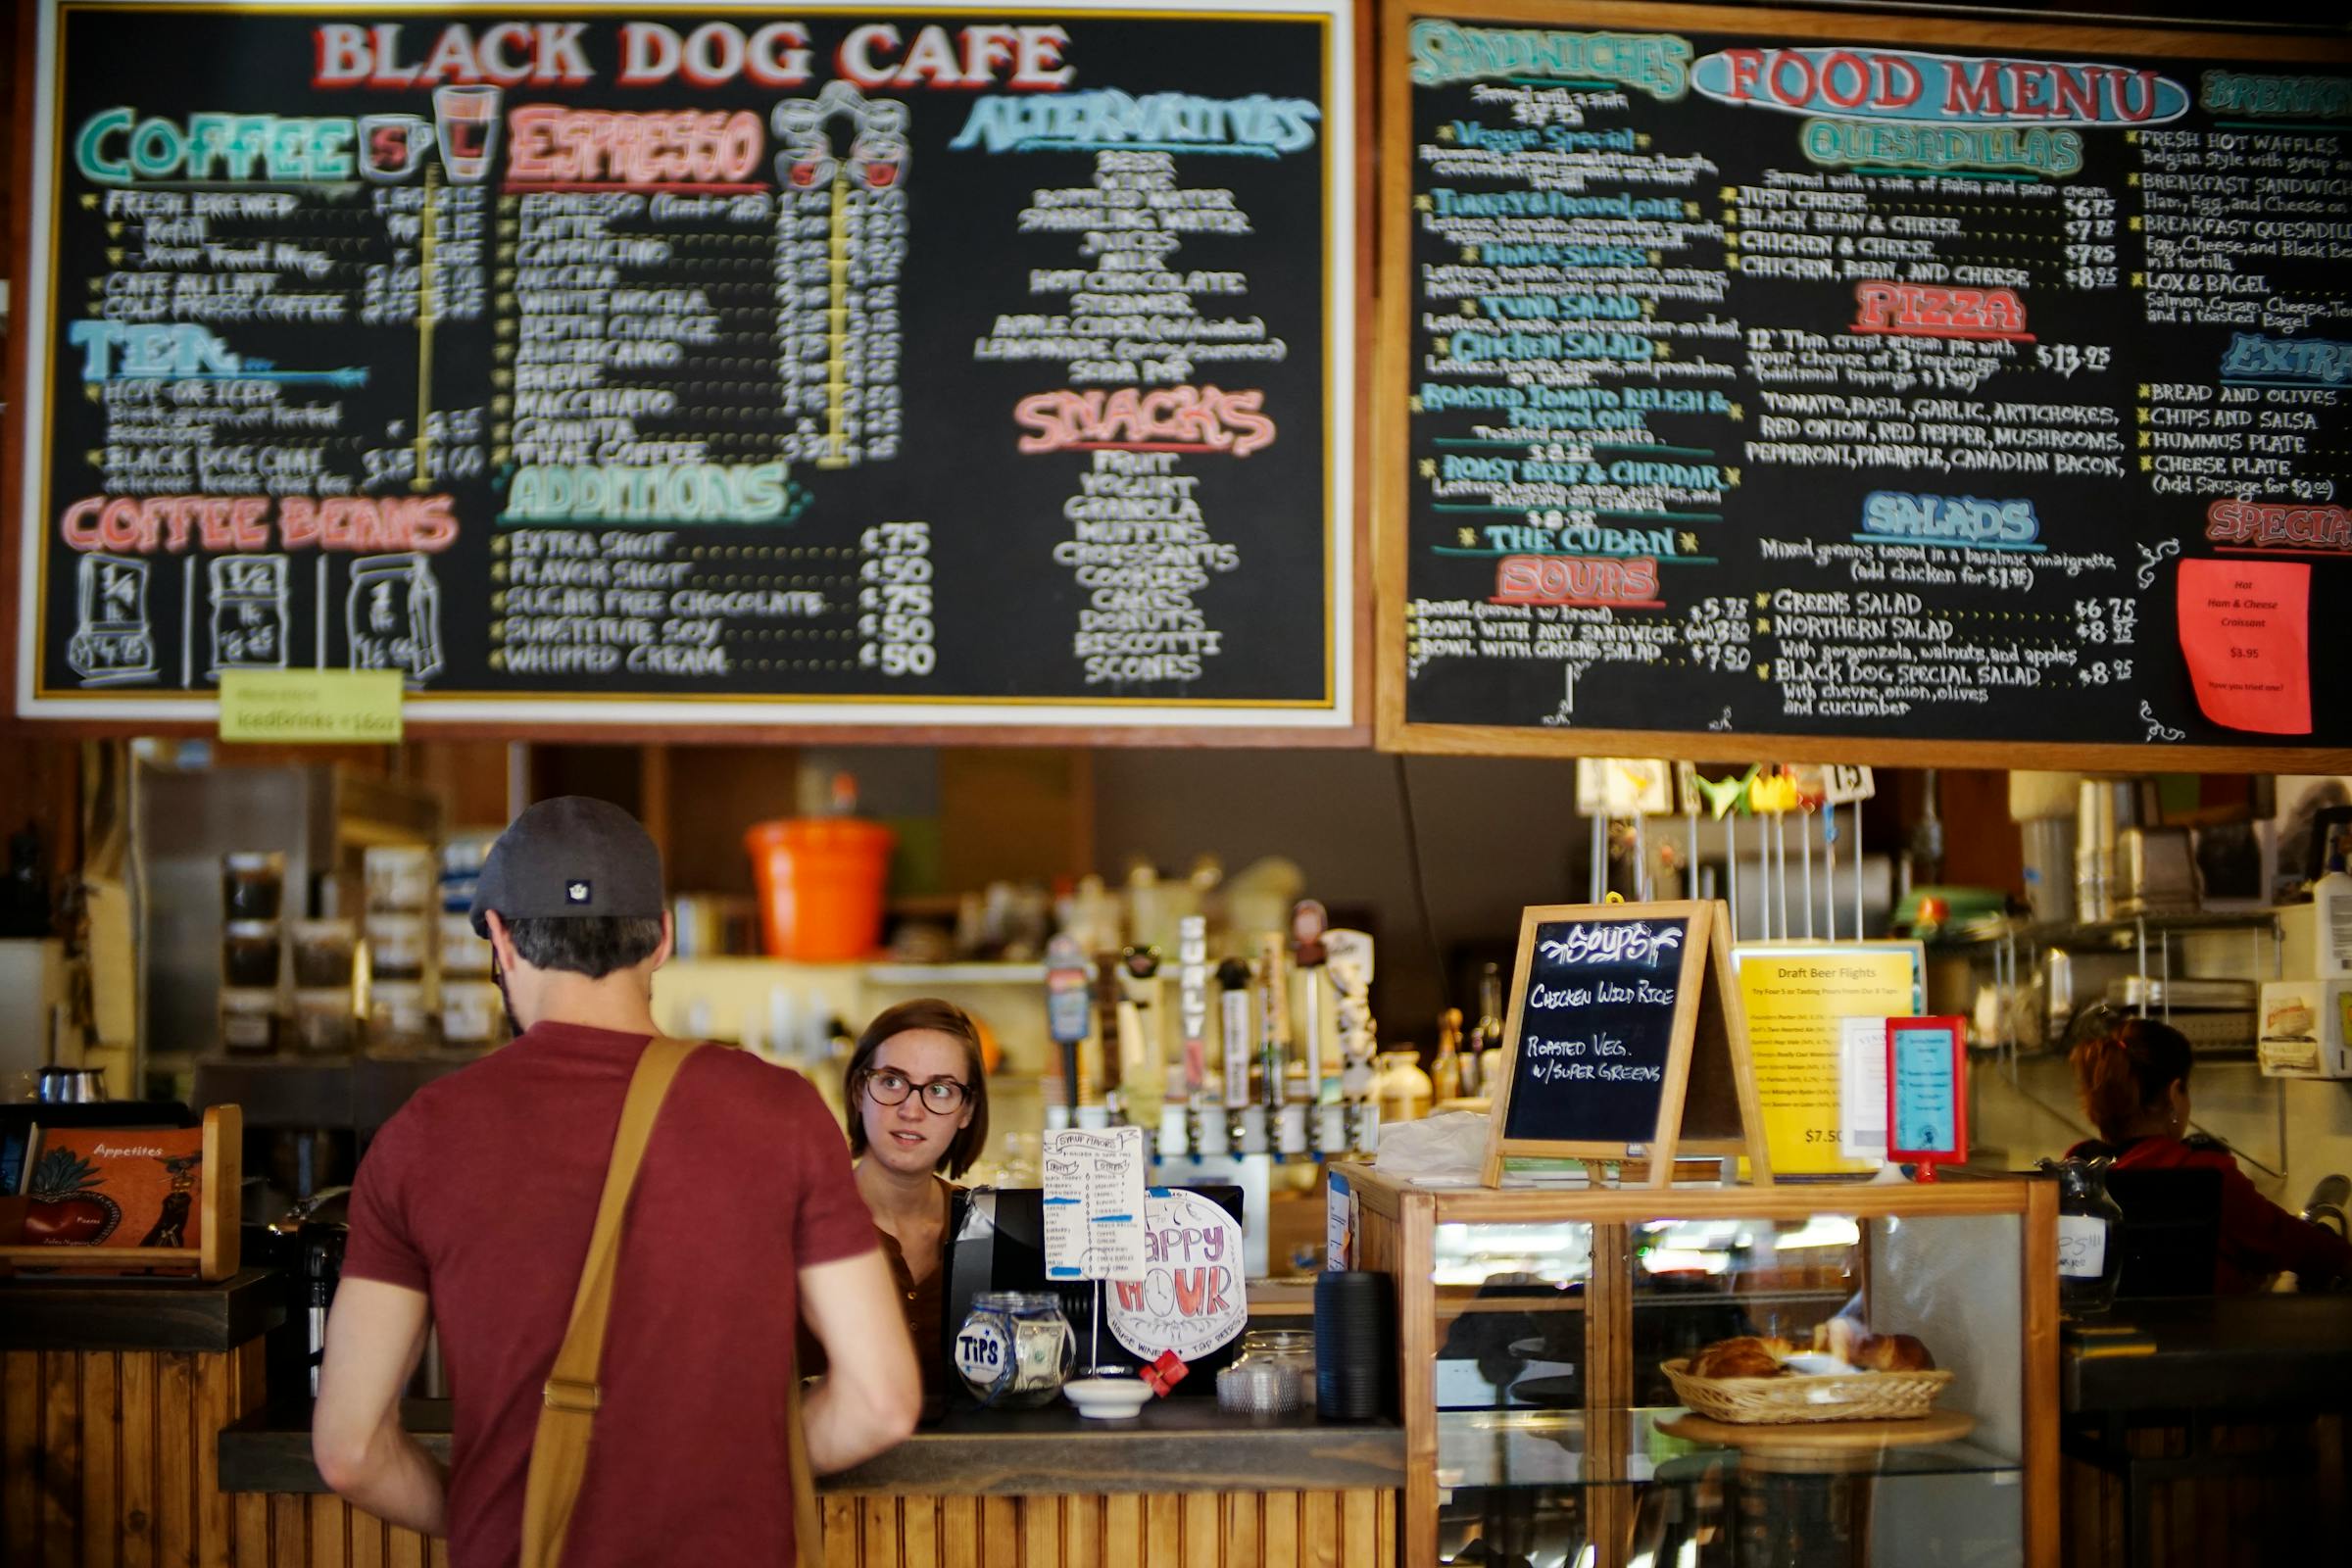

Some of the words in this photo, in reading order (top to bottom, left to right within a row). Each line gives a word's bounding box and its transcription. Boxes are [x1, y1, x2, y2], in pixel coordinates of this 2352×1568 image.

[312, 22, 595, 89] BLACK
[616, 22, 813, 89] DOG
[834, 24, 1077, 91] CAFE
[1723, 49, 1923, 109] FOOD
[1941, 59, 2161, 122] MENU
[949, 88, 1321, 155] ALTERNATIVES
[75, 107, 358, 184] COFFEE
[509, 104, 764, 183] ESPRESSO
[1800, 117, 2084, 176] QUESADILLAS
[2141, 130, 2200, 148] FRESH
[2207, 133, 2249, 151] HOT
[2254, 135, 2339, 156] WAFFLES
[2248, 152, 2283, 168] with
[2286, 155, 2330, 176] syrup
[2142, 172, 2250, 195] BREAKFAST
[2255, 176, 2352, 196] SANDWICH
[1078, 230, 1182, 258] JUICES
[2180, 253, 2233, 271] tortilla
[1907, 263, 1950, 283] AND
[1953, 265, 2030, 289] CHEESE
[2146, 271, 2184, 291] LOX
[2187, 273, 2205, 291] &
[2206, 274, 2271, 294] BAGEL
[1856, 281, 2027, 333] PIZZA
[2220, 333, 2352, 382] EXTRA
[2152, 383, 2213, 402] BREAD
[2220, 387, 2260, 404] AND
[2267, 389, 2337, 406] OLIVES
[1014, 384, 1277, 456] SNACKS
[1759, 415, 1800, 440] RED
[1877, 421, 1916, 442] RED
[2150, 408, 2210, 428] CHIPS
[2214, 410, 2252, 427] AND
[2260, 411, 2320, 430] SALSA
[2153, 431, 2242, 451] HUMMUS
[2249, 434, 2307, 454] PLATE
[1093, 450, 1180, 475] FRUIT
[1950, 448, 2049, 470] CANADIAN
[2156, 455, 2227, 474] CHEESE
[2231, 456, 2291, 476] PLATE
[1443, 455, 1519, 483] ROAST
[1520, 458, 1584, 483] BEEF
[1608, 460, 1732, 491] CHEDDAR
[505, 466, 790, 522] ADDITIONS
[2196, 476, 2262, 504] Sausage
[2265, 475, 2289, 493] for
[62, 497, 270, 551] COFFEE
[279, 493, 459, 551] BEANS
[1063, 496, 1203, 521] GRANOLA
[1864, 490, 2040, 544] SALADS
[1075, 520, 1211, 545] MUFFINS
[2208, 500, 2352, 547] SPECIA
[510, 530, 597, 559] EXTRA
[601, 531, 677, 560] SHOT
[1484, 525, 1556, 552] THE
[1560, 527, 1678, 556] CUBAN
[1053, 541, 1240, 572] CROISSANTS
[612, 561, 694, 588] SHOT
[1075, 565, 1210, 588] COOKIES
[1496, 553, 1660, 600] SOUPS
[2234, 581, 2253, 590] Hot
[504, 587, 601, 616] SUGAR
[604, 589, 667, 616] FREE
[1092, 588, 1194, 612] CAKES
[1773, 588, 1851, 614] GREENS
[1855, 591, 1923, 615] SALAD
[2208, 599, 2231, 609] Ham
[2233, 599, 2241, 609] &
[2243, 600, 2278, 610] Cheese
[1418, 617, 1477, 638] BOWL
[1479, 619, 1531, 640] WITH
[1537, 621, 1576, 641] ANY
[1580, 622, 1677, 644] SANDWICH
[1775, 613, 1887, 640] NORTHERN
[1890, 616, 1954, 642] SALAD
[2221, 618, 2267, 628] Croissant
[1074, 631, 1222, 658] BISCOTTI
[1420, 637, 1478, 658] BOWL
[1480, 639, 1533, 659] WITH
[1603, 641, 1663, 662] SALAD
[2230, 647, 2259, 660] $3.95
[504, 644, 621, 674] WHIPPED
[625, 645, 730, 674] CREAM
[1085, 654, 1203, 684] SCONES
[1775, 658, 1843, 683] BLACK
[1846, 661, 1895, 683] DOG
[1897, 663, 1973, 685] SPECIAL
[1976, 665, 2041, 687] SALAD
[1567, 923, 1652, 963] SOUPS
[1778, 967, 1807, 979] Draft
[1810, 967, 1837, 978] Beer
[1839, 967, 1877, 980] Flights
[1531, 983, 1592, 1009] CHICKEN
[1597, 981, 1636, 1004] WILD
[1638, 979, 1675, 1005] RICE
[1527, 1035, 1587, 1058] ROASTED
[1593, 1031, 1633, 1057] VEG.
[1598, 1062, 1662, 1082] GREENS
[93, 1143, 164, 1157] Appetites
[1146, 1225, 1224, 1262] APPY
[1111, 1320, 1135, 1347] HOUSE
[1138, 1341, 1163, 1357] WINE
